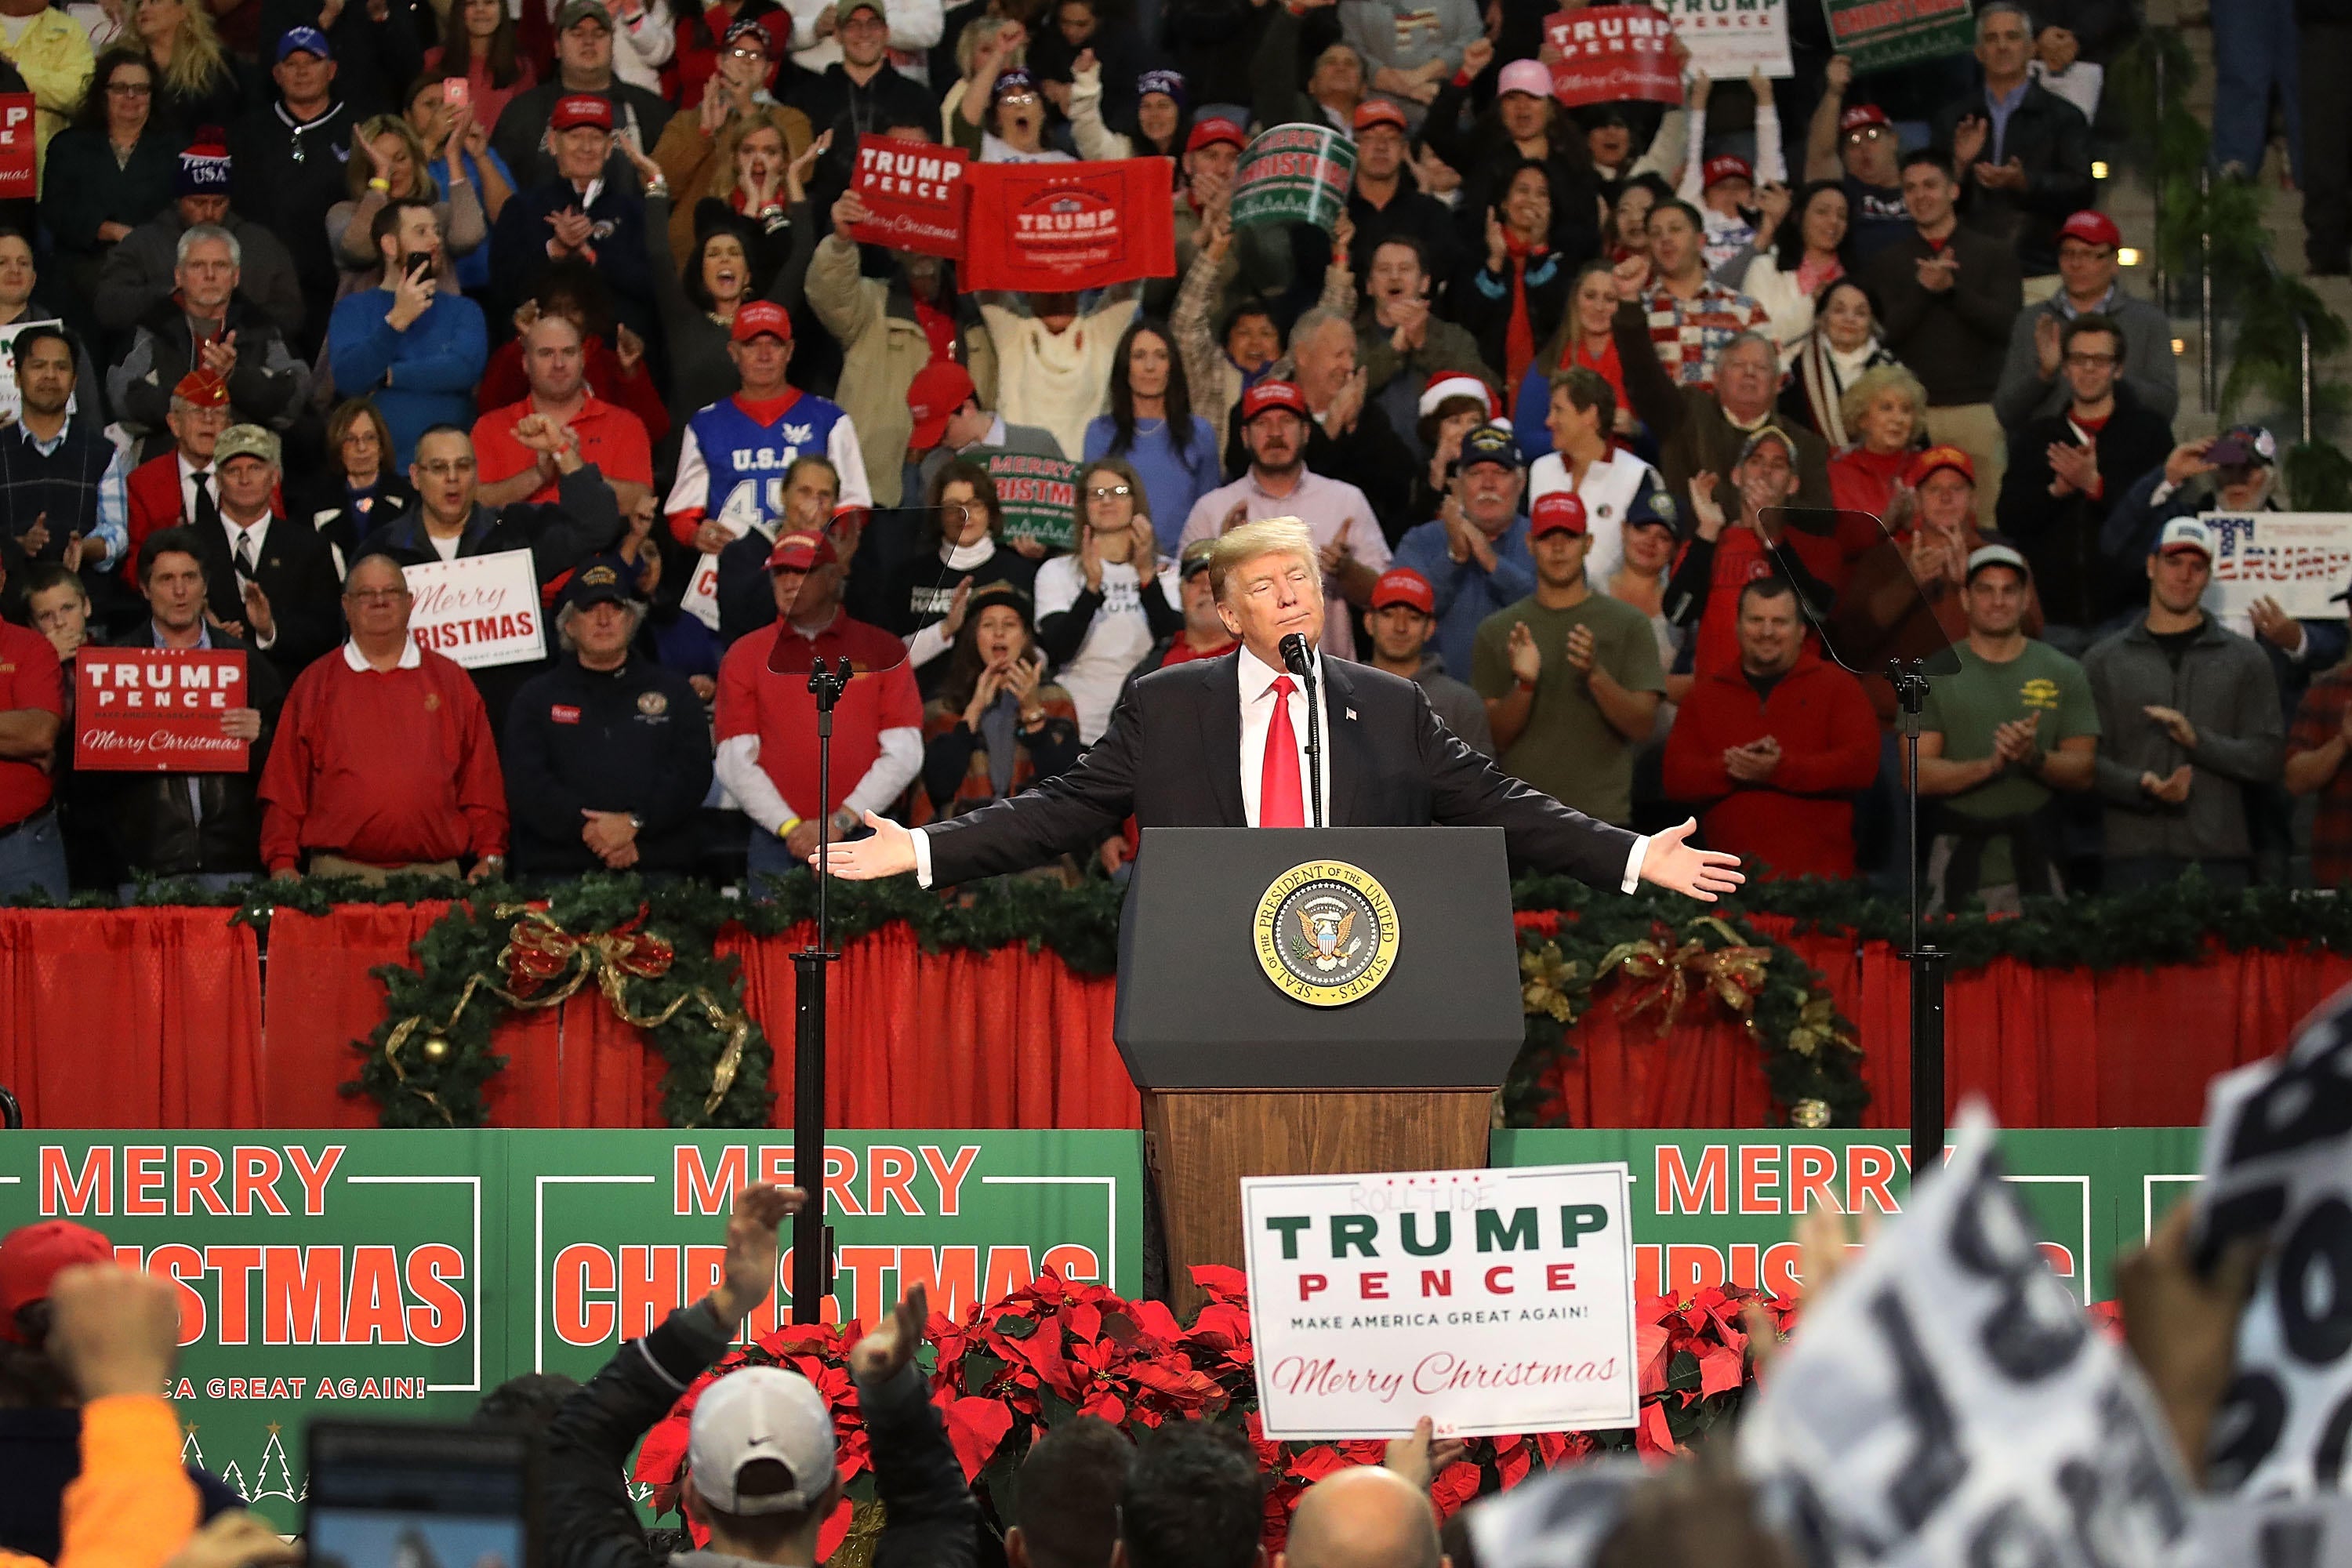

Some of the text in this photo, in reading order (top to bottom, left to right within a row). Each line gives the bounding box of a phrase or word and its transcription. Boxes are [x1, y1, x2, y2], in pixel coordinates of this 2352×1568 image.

[1550, 17, 1671, 45] TRUMP
[1563, 38, 1664, 58] PENCE
[191, 167, 227, 184] USA
[862, 148, 962, 183] TRUMP
[863, 173, 949, 200] PENCE
[1017, 208, 1116, 230] TRUMP
[989, 455, 1076, 479] MERRY
[993, 477, 1076, 507] RISTM
[2205, 517, 2350, 580] TRUMP
[412, 583, 506, 615] Merry
[413, 612, 534, 649] RISTMAS
[85, 663, 241, 689] TRUMP
[99, 691, 227, 708] PENCE
[82, 728, 241, 753] Merry Christmas
[1259, 866, 1394, 998] SEAL OF THE PRESIDENT OF THE UNITED STATES
[39, 1145, 347, 1216] MERRY
[673, 1145, 981, 1216] MERRY
[1655, 1145, 1956, 1215] MERR
[1266, 1204, 1608, 1260] TRUMP
[114, 1243, 466, 1346] STMAS
[1299, 1263, 1576, 1301] PENCE
[1290, 1306, 1588, 1330] MAKE AMERICA GREAT AGAIN!
[206, 1377, 307, 1399] GREAT
[315, 1377, 425, 1399] AGAIN!
[1272, 1351, 1618, 1403] Merry Christmas
